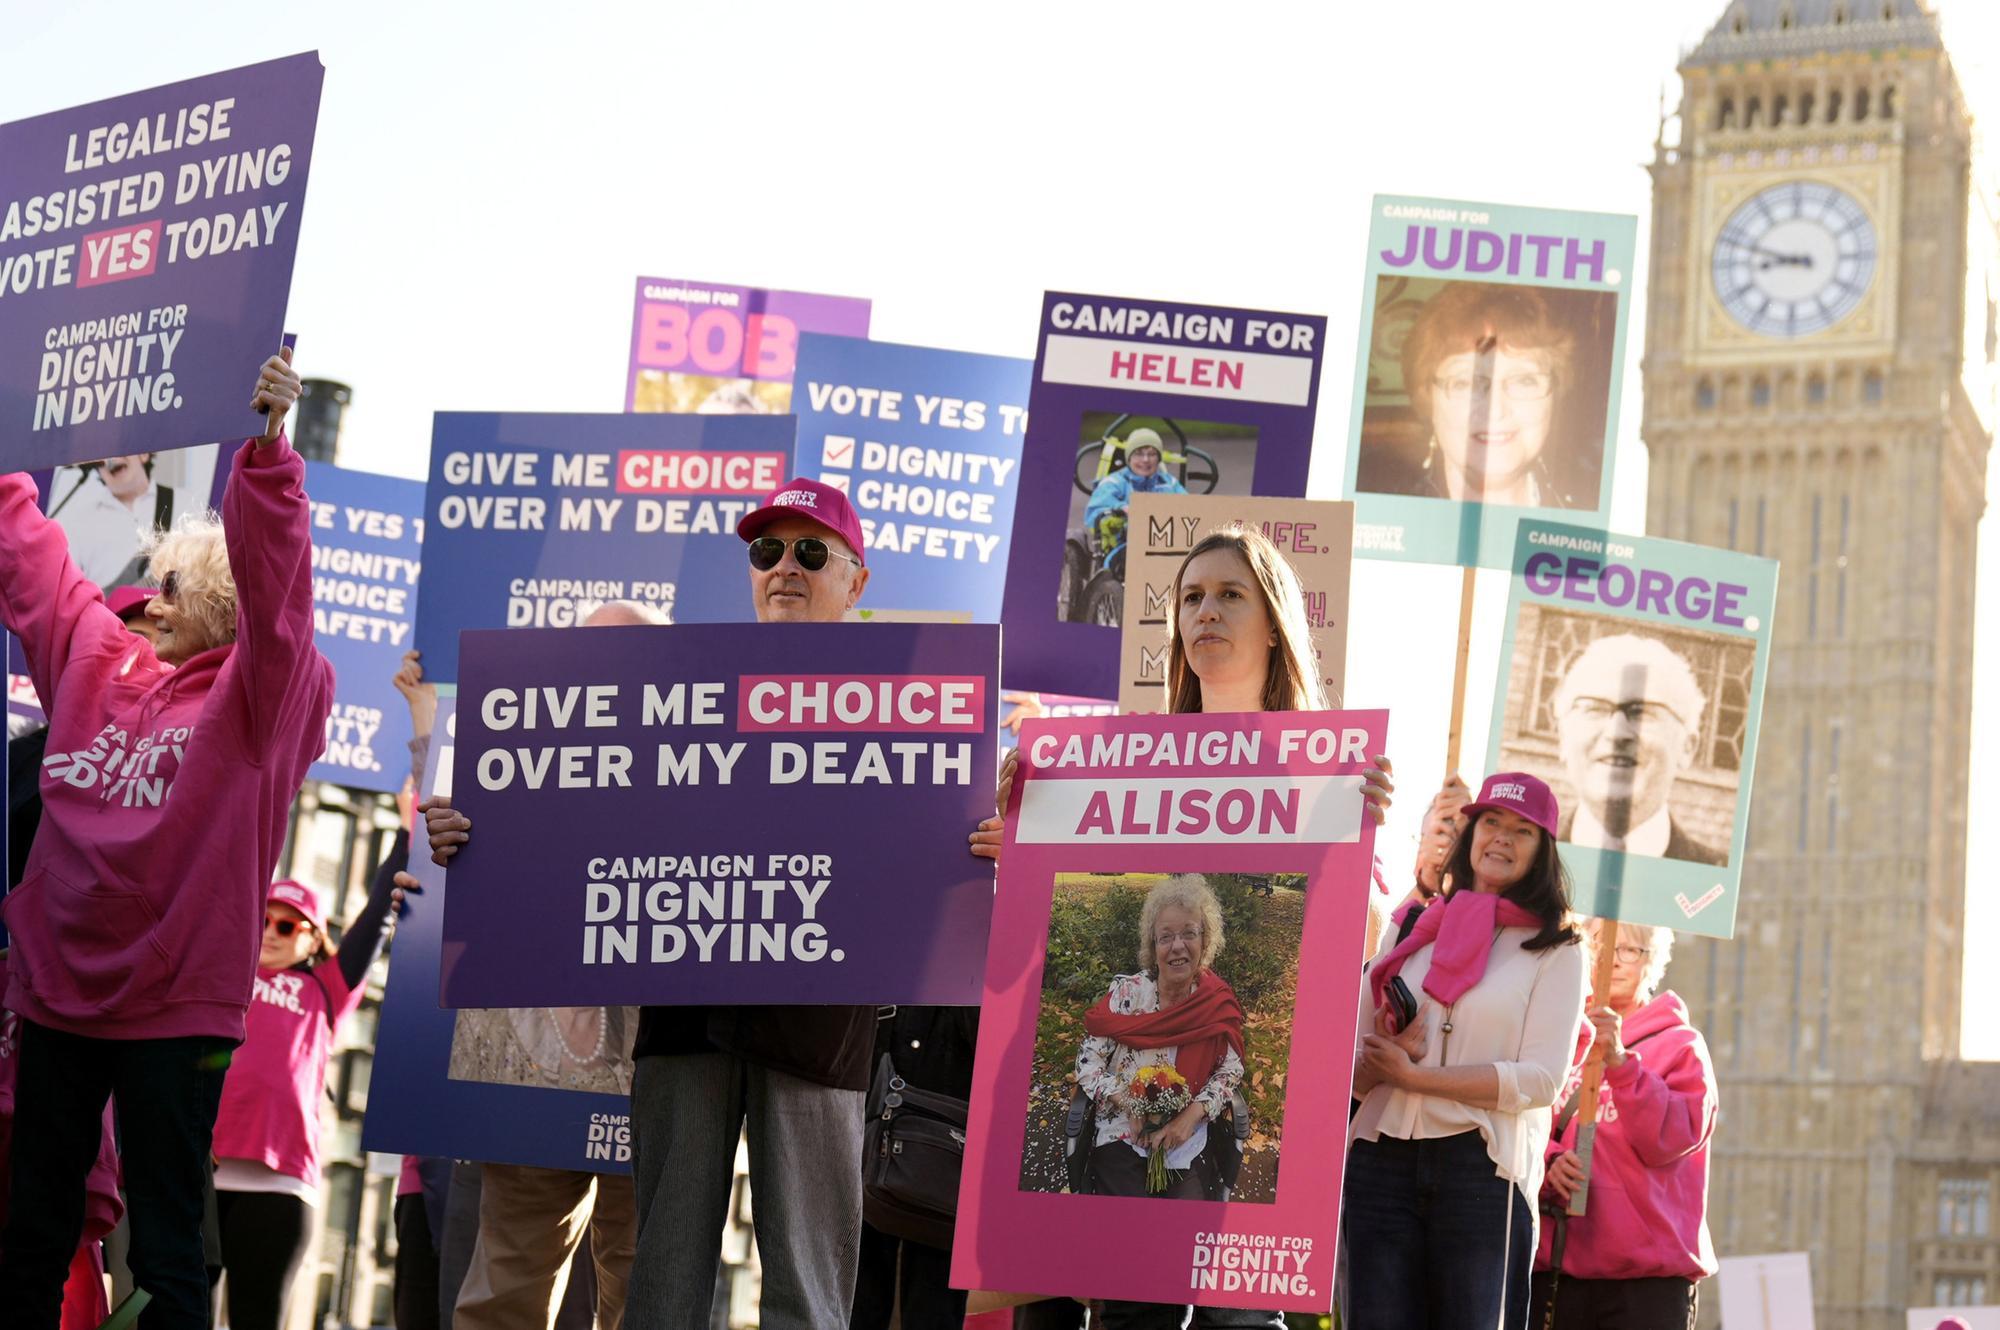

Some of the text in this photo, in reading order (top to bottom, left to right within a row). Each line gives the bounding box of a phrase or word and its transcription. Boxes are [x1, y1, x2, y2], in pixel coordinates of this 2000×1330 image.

[65, 97, 235, 174] LEGALISE
[0, 143, 291, 243] ASSISTED DYING
[1383, 204, 1490, 226] CAMPAIGN FOR
[87, 229, 153, 279] YES
[166, 202, 288, 263] TODAY
[644, 284, 740, 307] CAMPAIGN FOR
[45, 304, 188, 350] CAMPAIGN FOR
[1051, 302, 1315, 351] CAMPAIGN FOR
[39, 329, 184, 391] DIGNITY
[1110, 351, 1244, 390] HELEN
[32, 372, 183, 432] IN DYING.
[808, 382, 903, 421] VOTE
[915, 394, 987, 431] YES
[443, 452, 778, 490] GIVE ME CHOICE
[861, 441, 1015, 487] DIGNITY
[439, 496, 546, 531] OVER
[560, 498, 622, 532] MY
[857, 480, 995, 523] CHOICE
[345, 506, 404, 540] YES
[1149, 515, 1200, 548] MY
[1528, 530, 1635, 560] CAMPAIGN FOR
[312, 576, 407, 615] HOICE
[510, 578, 676, 600] CAMPAIGN FOR
[1524, 551, 1760, 632] GEORGE.
[314, 608, 409, 647] AFETY
[481, 682, 974, 731] GIVE ME CHOICE
[477, 742, 972, 792] OVER MY DEATH
[1030, 728, 1369, 768] CAMPAIGN FOR
[1074, 788, 1300, 835] ALISON
[587, 854, 832, 881] CAMPAIGN FOR
[585, 880, 831, 923] DIGNITY
[583, 923, 845, 965] IN DYING.
[590, 1113, 631, 1126] CAMP
[586, 1142, 612, 1161] IN
[1192, 1245, 1311, 1273] DIGNITY
[1195, 1232, 1313, 1250] CAMPAIGN FOR
[1190, 1268, 1316, 1297] IN DYING.
